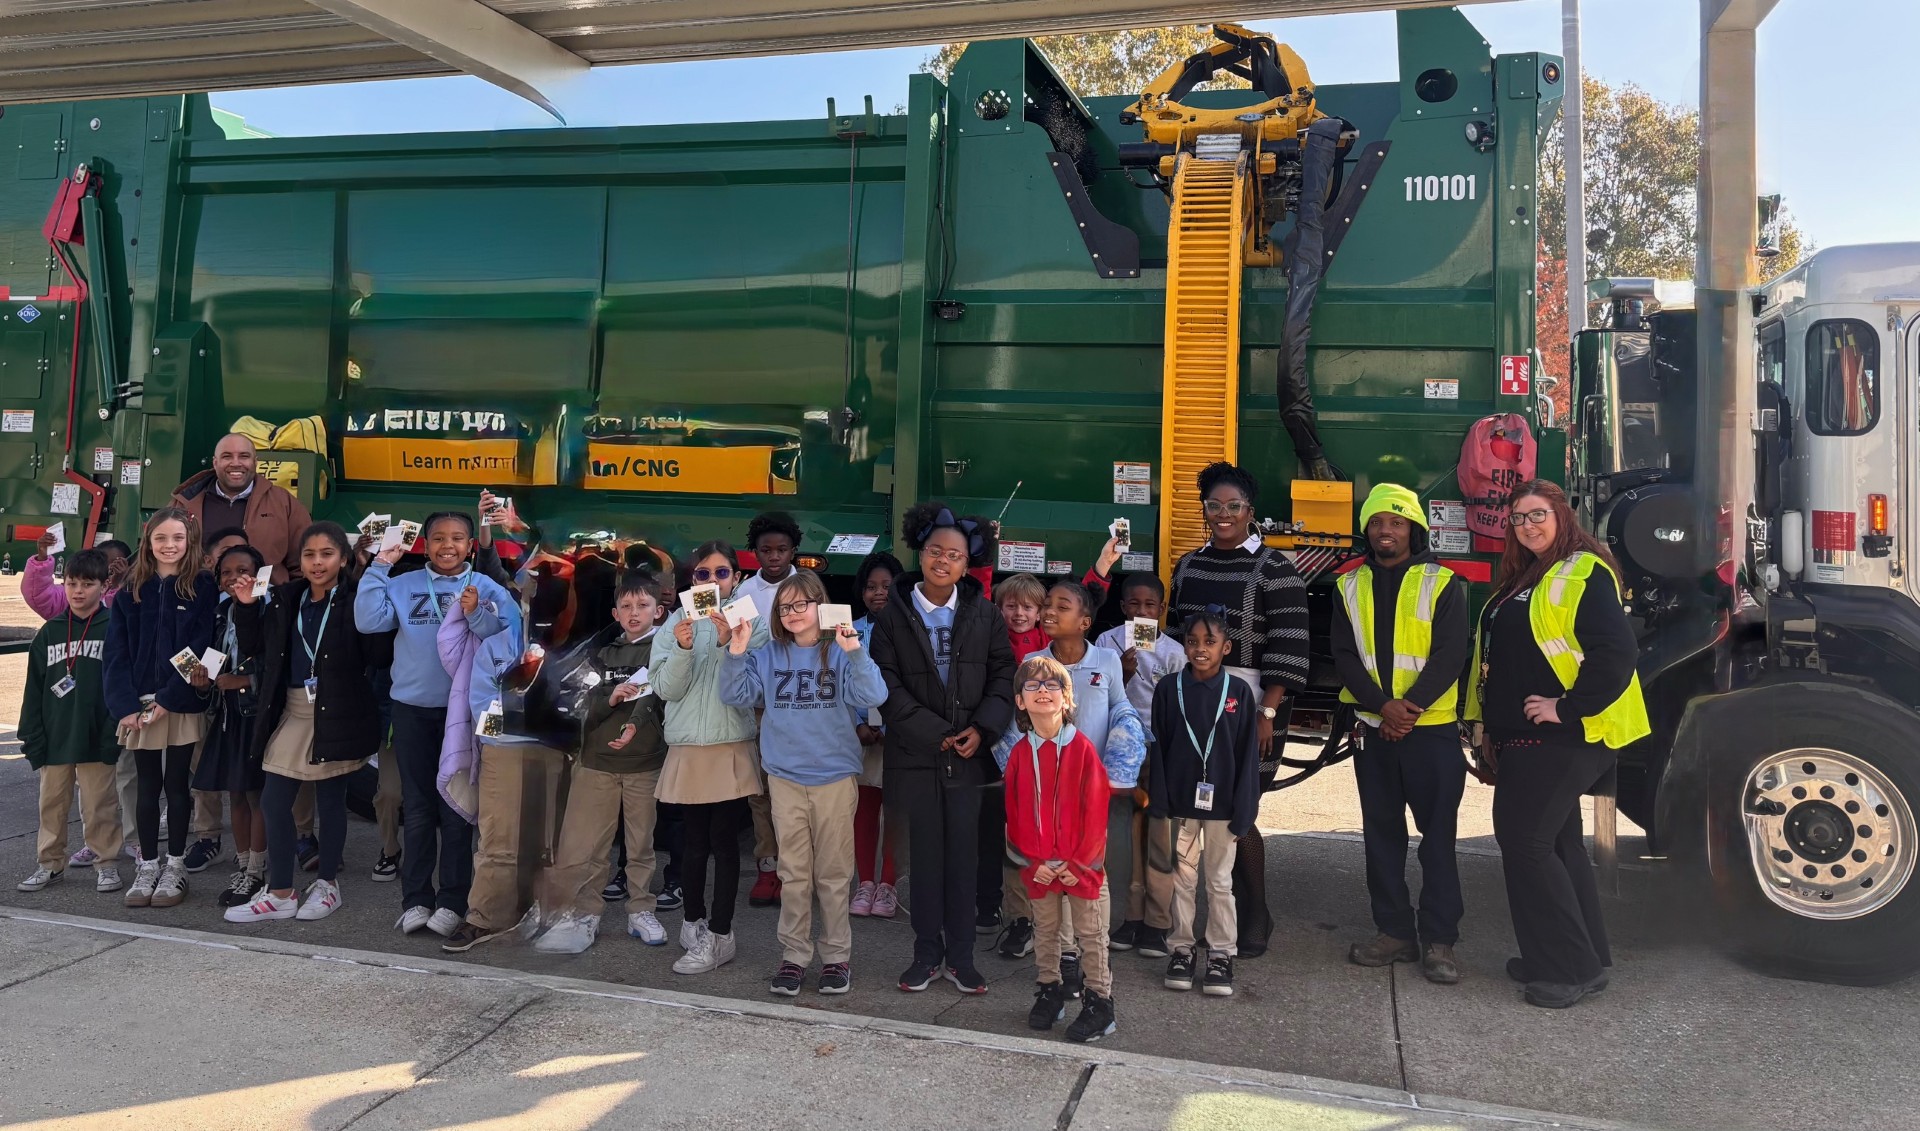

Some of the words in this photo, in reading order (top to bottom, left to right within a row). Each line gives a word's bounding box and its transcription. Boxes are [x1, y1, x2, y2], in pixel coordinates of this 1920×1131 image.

[1403, 174, 1476, 201] 110101
[402, 450, 453, 469] Learn
[1476, 512, 1499, 528] KEEP
[408, 592, 455, 619] ZE
[1135, 641, 1152, 649] WM
[773, 668, 837, 703] ZES
